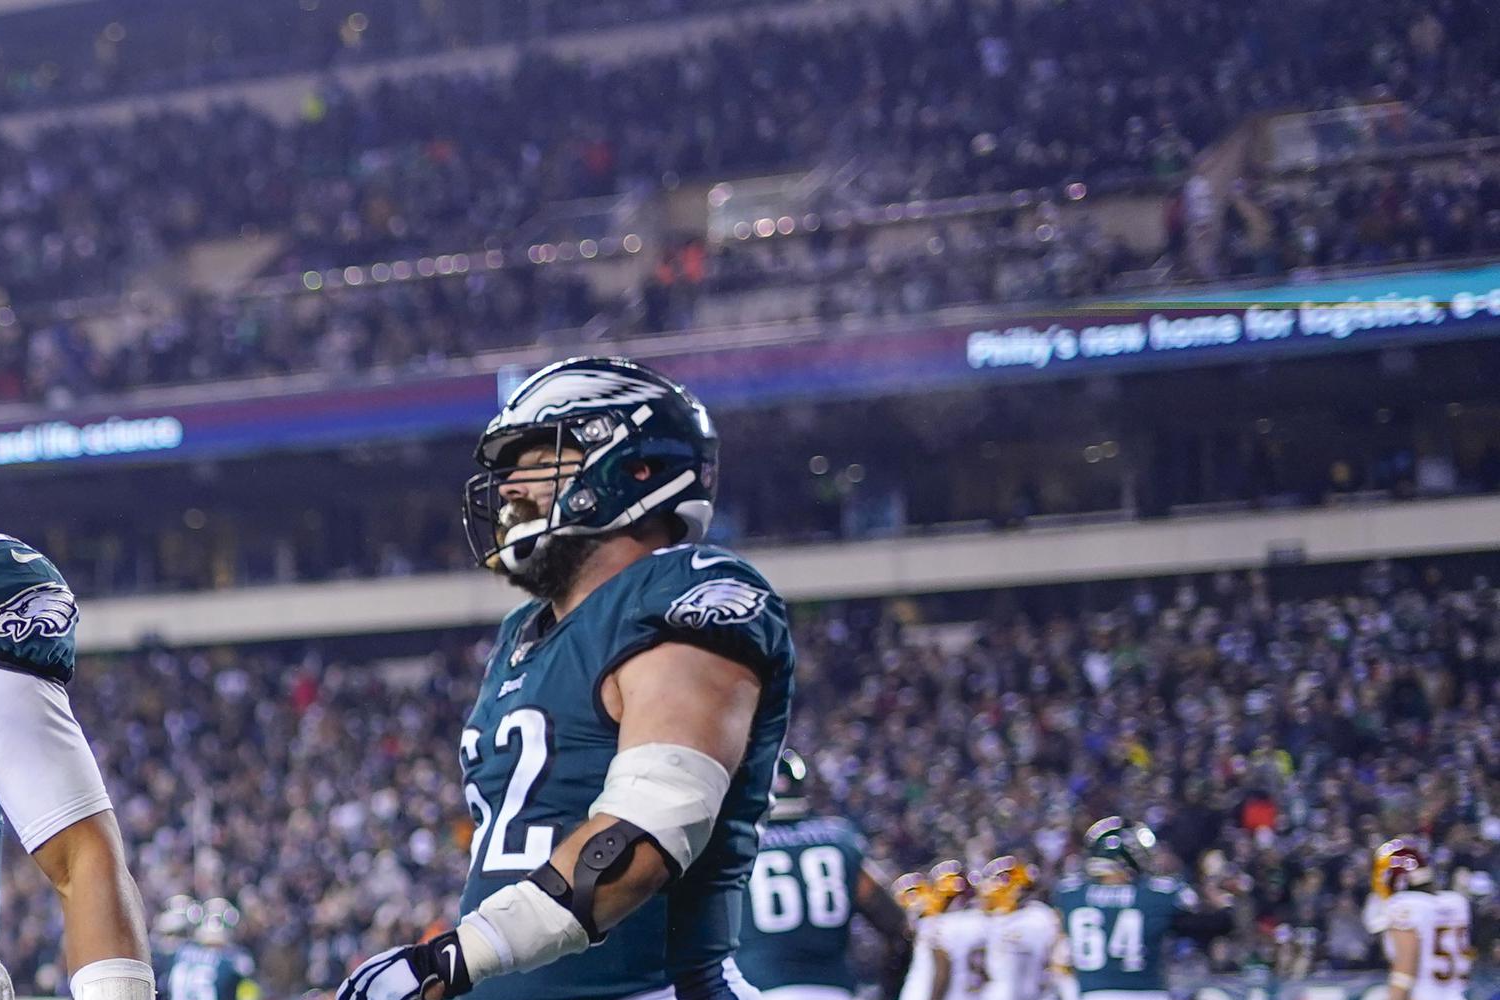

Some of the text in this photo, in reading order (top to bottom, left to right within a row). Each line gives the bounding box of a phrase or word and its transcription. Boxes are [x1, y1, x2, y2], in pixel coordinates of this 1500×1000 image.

[459, 706, 556, 878] 62
[749, 845, 850, 933] 68
[1068, 906, 1146, 972] 64
